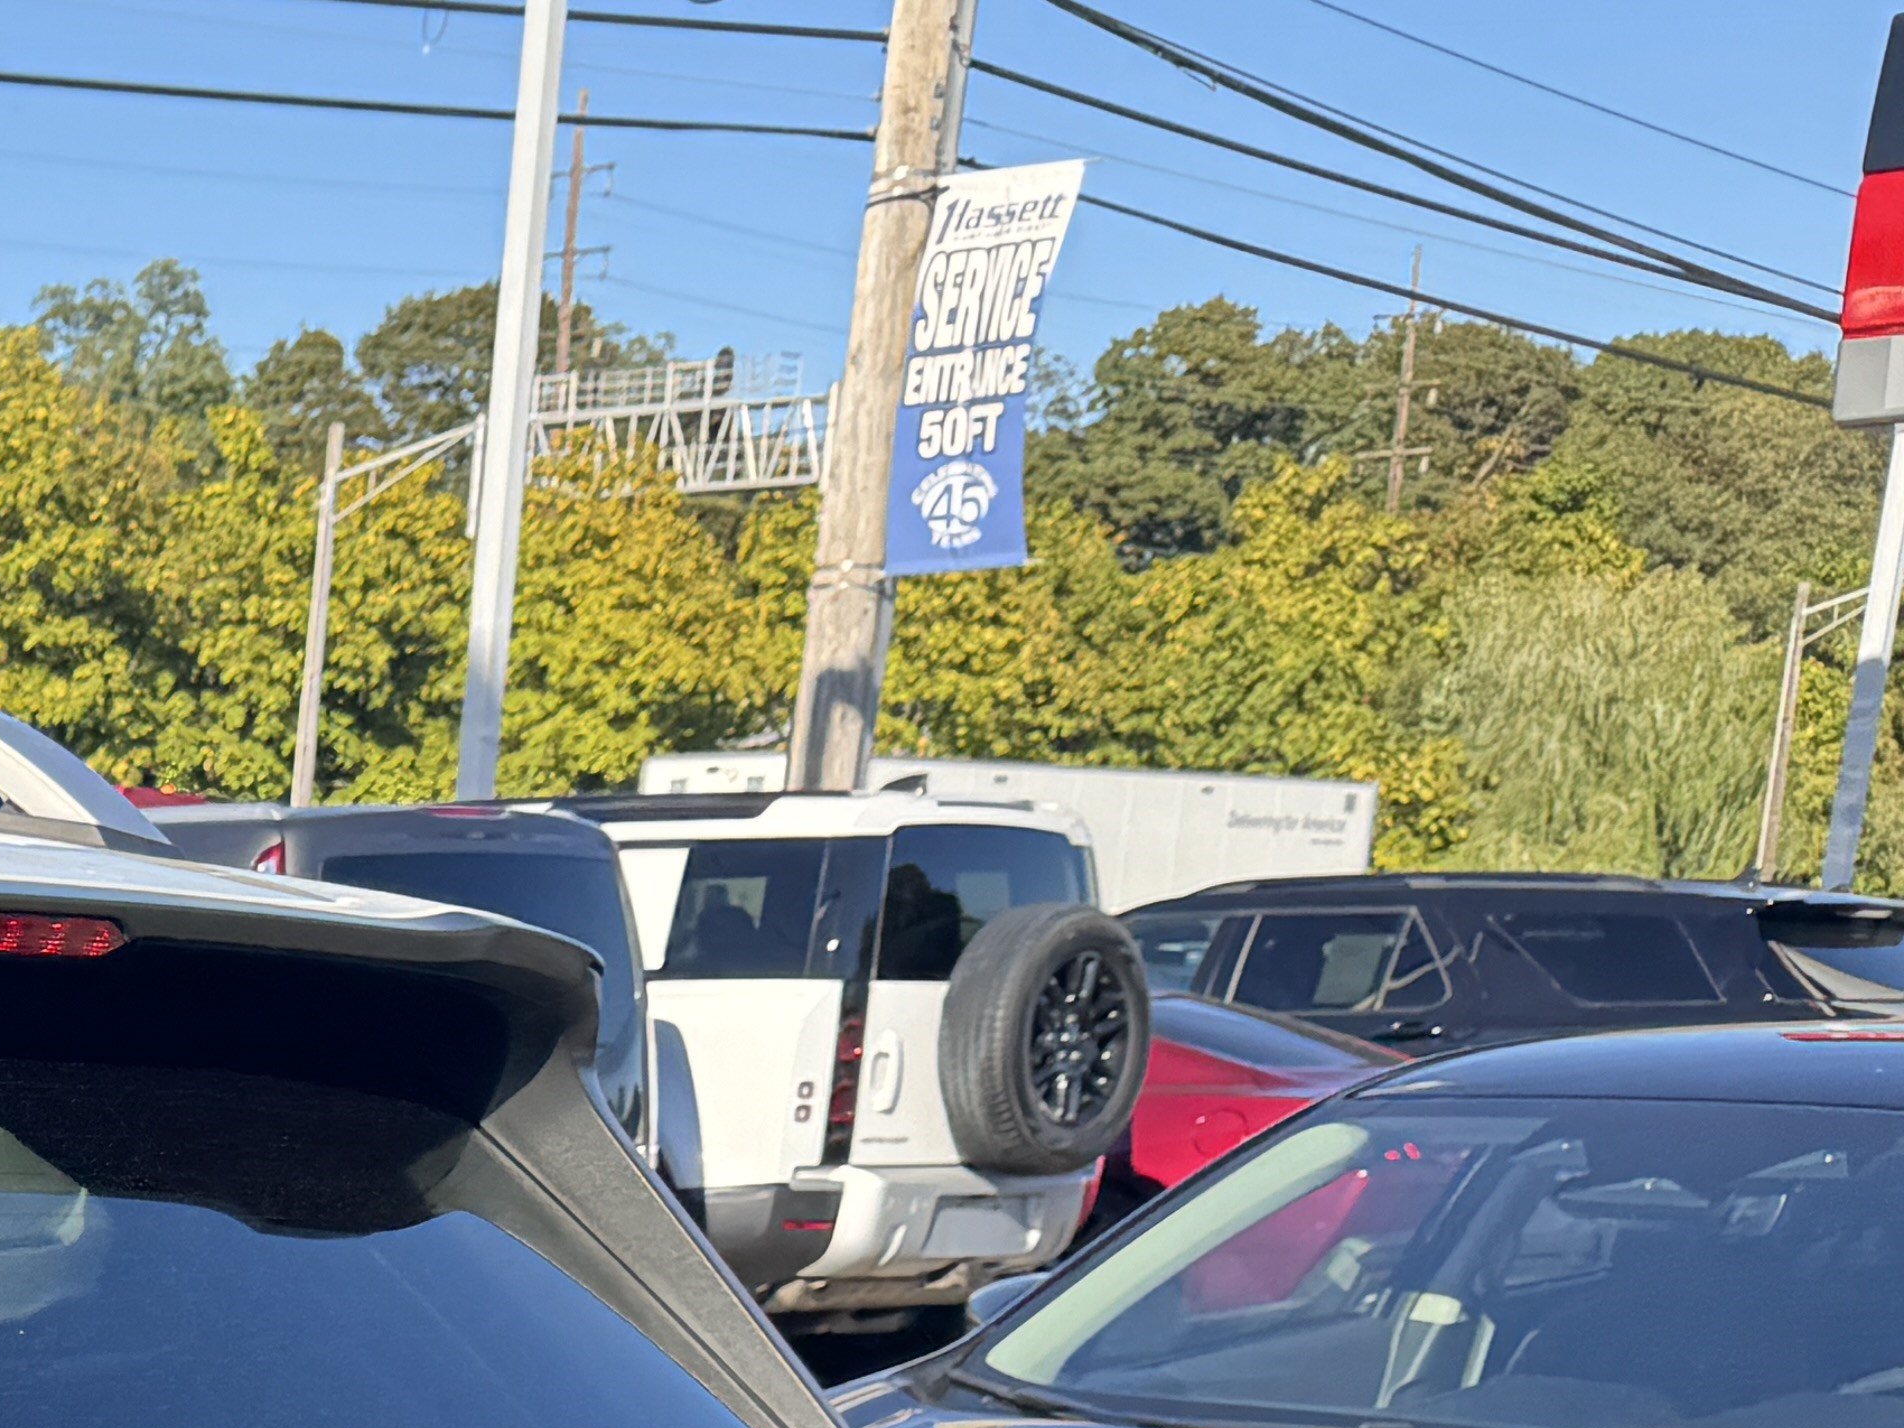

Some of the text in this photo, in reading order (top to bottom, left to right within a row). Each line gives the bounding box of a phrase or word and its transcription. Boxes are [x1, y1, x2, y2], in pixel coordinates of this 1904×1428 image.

[914, 238, 1054, 350] SERVICE
[904, 344, 1030, 406] ENTRANCE
[926, 482, 985, 529] 45
